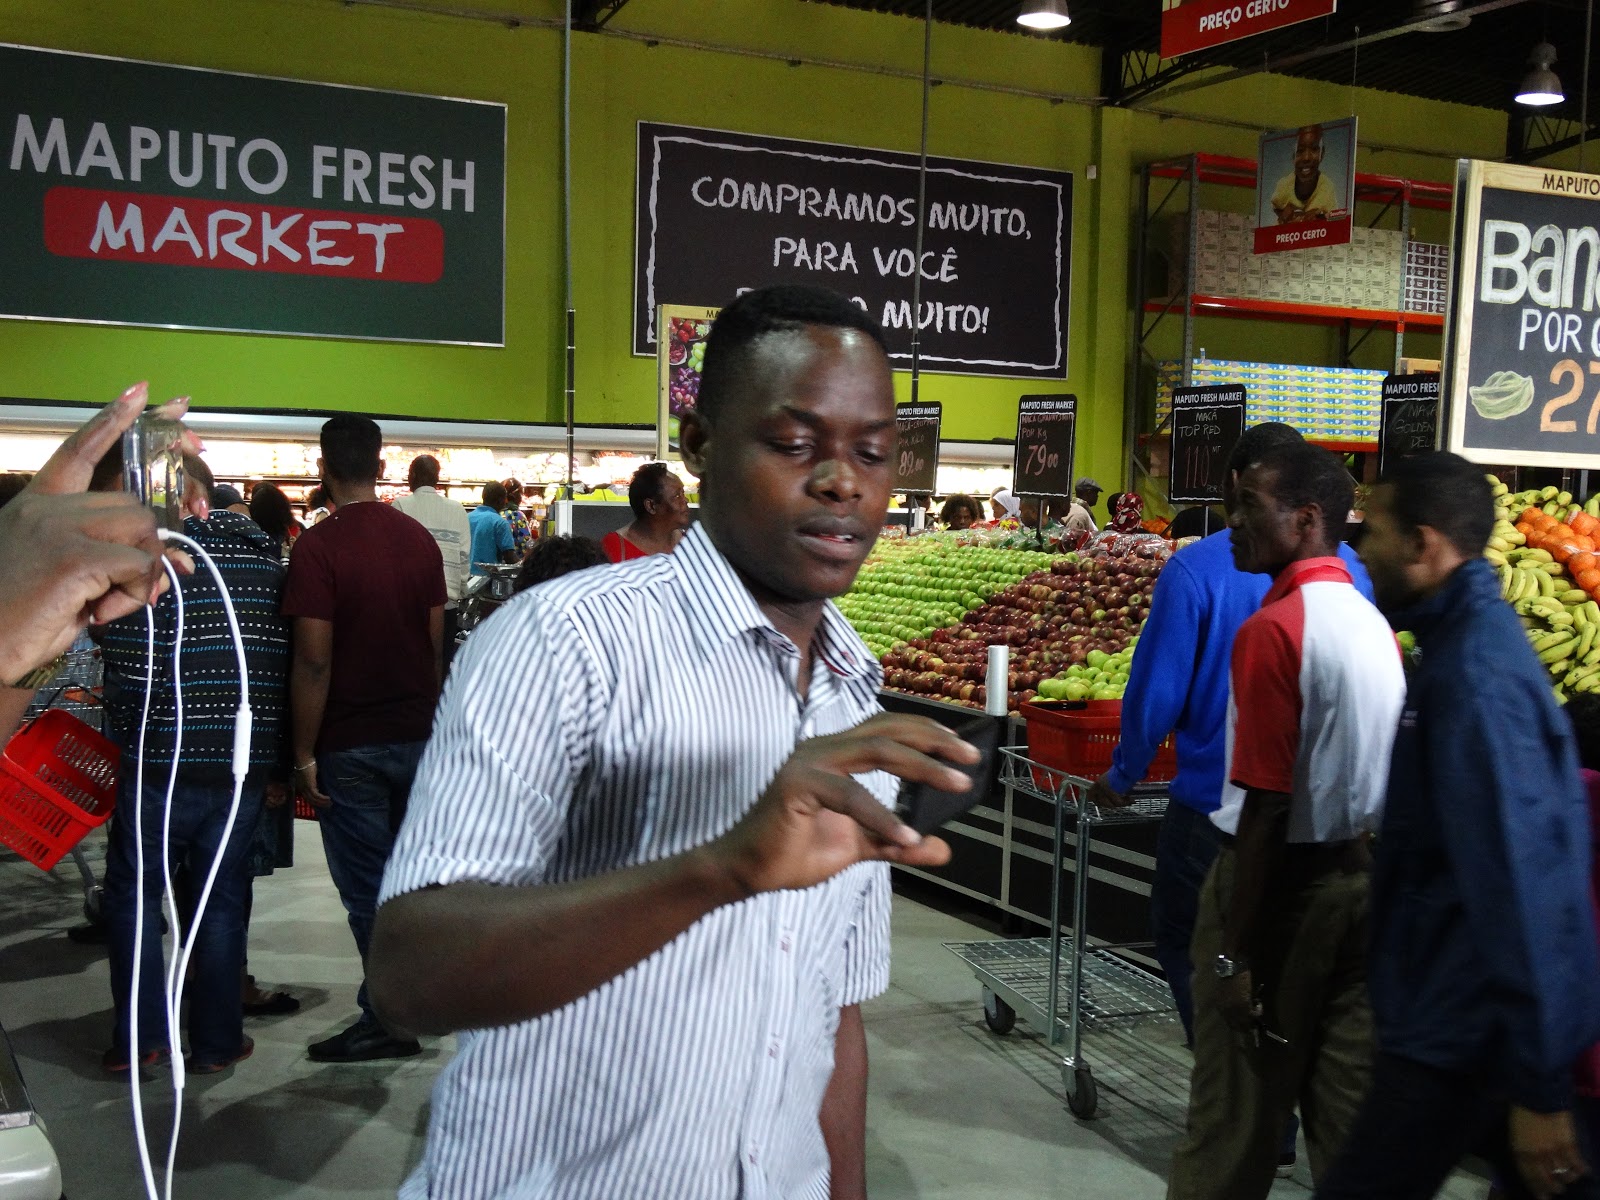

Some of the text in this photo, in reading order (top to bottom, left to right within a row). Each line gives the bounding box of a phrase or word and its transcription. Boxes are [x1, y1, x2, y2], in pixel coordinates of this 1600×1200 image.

[1199, 0, 1290, 33] PREÇO CERTO
[9, 113, 475, 213] MAPUTO FRESH
[1541, 173, 1600, 196] MAPUTO
[691, 175, 1032, 240] COMPRAMOS MUITO,
[89, 200, 404, 273] MARKET
[1275, 228, 1327, 244] PREÇO CERTO
[773, 236, 959, 283] PARA VOCÊ
[1480, 218, 1600, 312] Ban
[881, 299, 990, 335] MUITO!
[1518, 308, 1583, 354] POR
[1020, 400, 1075, 410] MAPUTO FRESH MARKET
[1174, 391, 1243, 404] MAPUTO FRESH MARKET
[1385, 383, 1418, 394] MAPUTO
[913, 407, 924, 415] FRESH
[924, 406, 940, 415] MARKET
[1179, 423, 1221, 440] TOP RED
